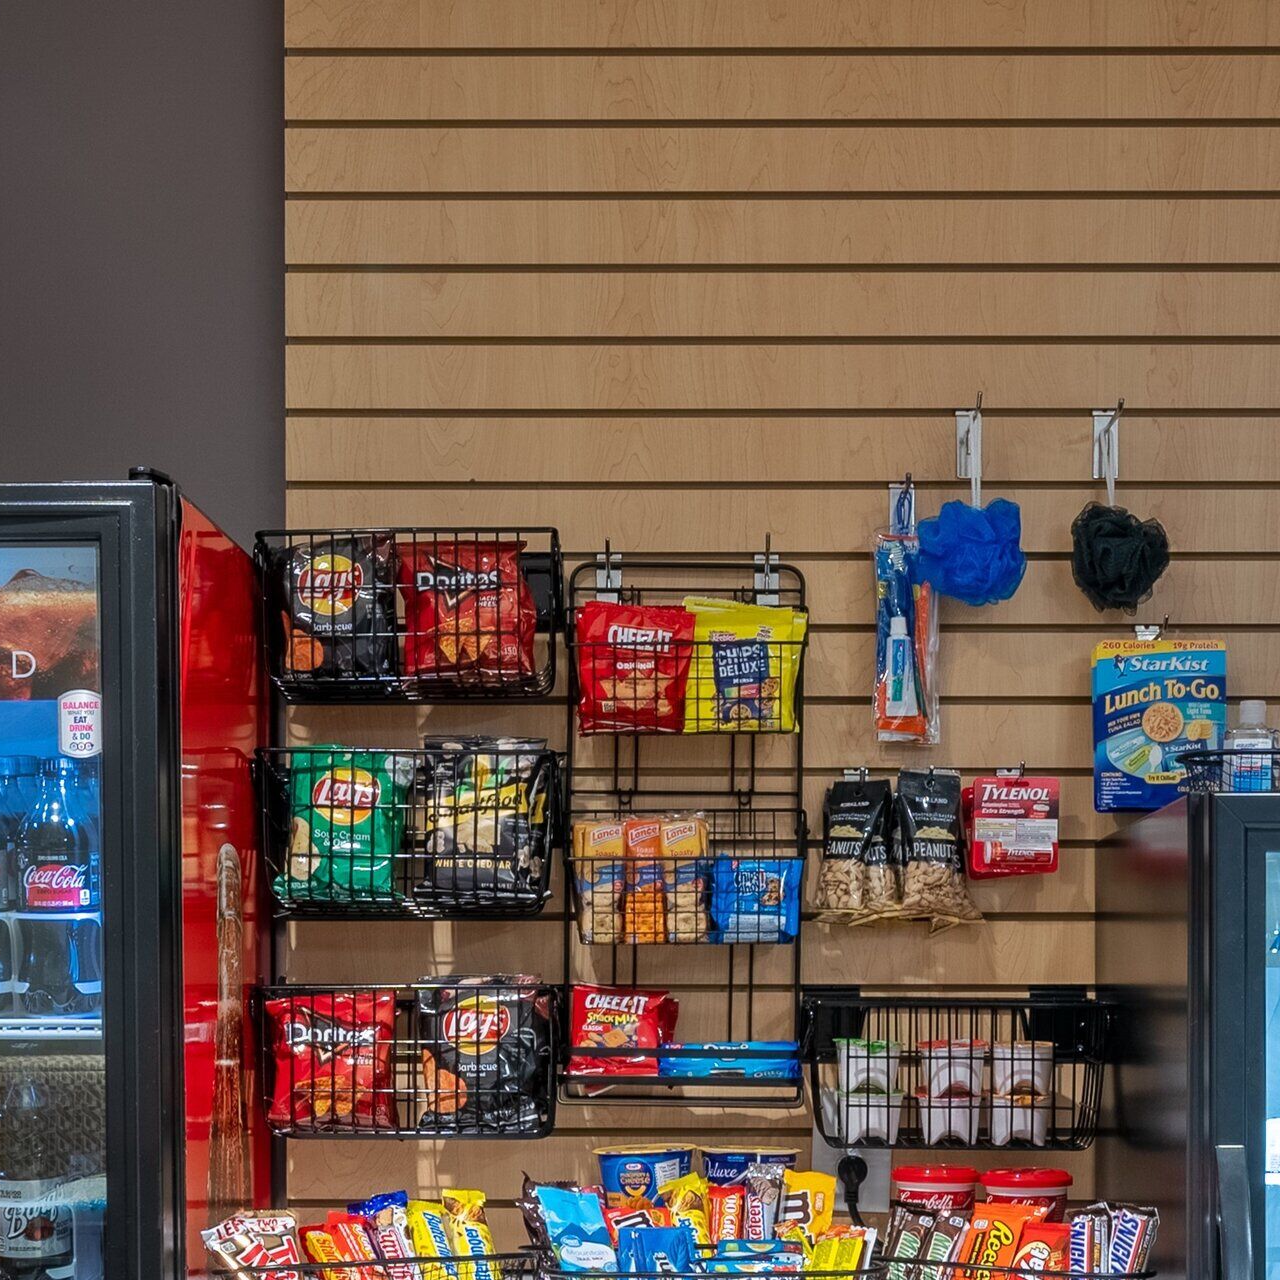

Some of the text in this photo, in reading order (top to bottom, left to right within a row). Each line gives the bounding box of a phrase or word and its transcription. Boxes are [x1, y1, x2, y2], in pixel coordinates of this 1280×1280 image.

[1173, 642, 1188, 650] 19g
[1129, 654, 1210, 672] StarKist
[62, 701, 100, 710] BALANCE
[1104, 680, 1162, 716] Lunch
[69, 724, 93, 732] DRINK
[73, 716, 87, 724] EAT
[1169, 742, 1202, 752] StarKist
[981, 784, 1050, 801] TYLENOL
[591, 827, 620, 841] Lance
[629, 825, 657, 841] Lance
[665, 823, 694, 840] Lance
[23, 864, 89, 889] Coca-Cola
[584, 992, 648, 1015] CHEEZ-IT
